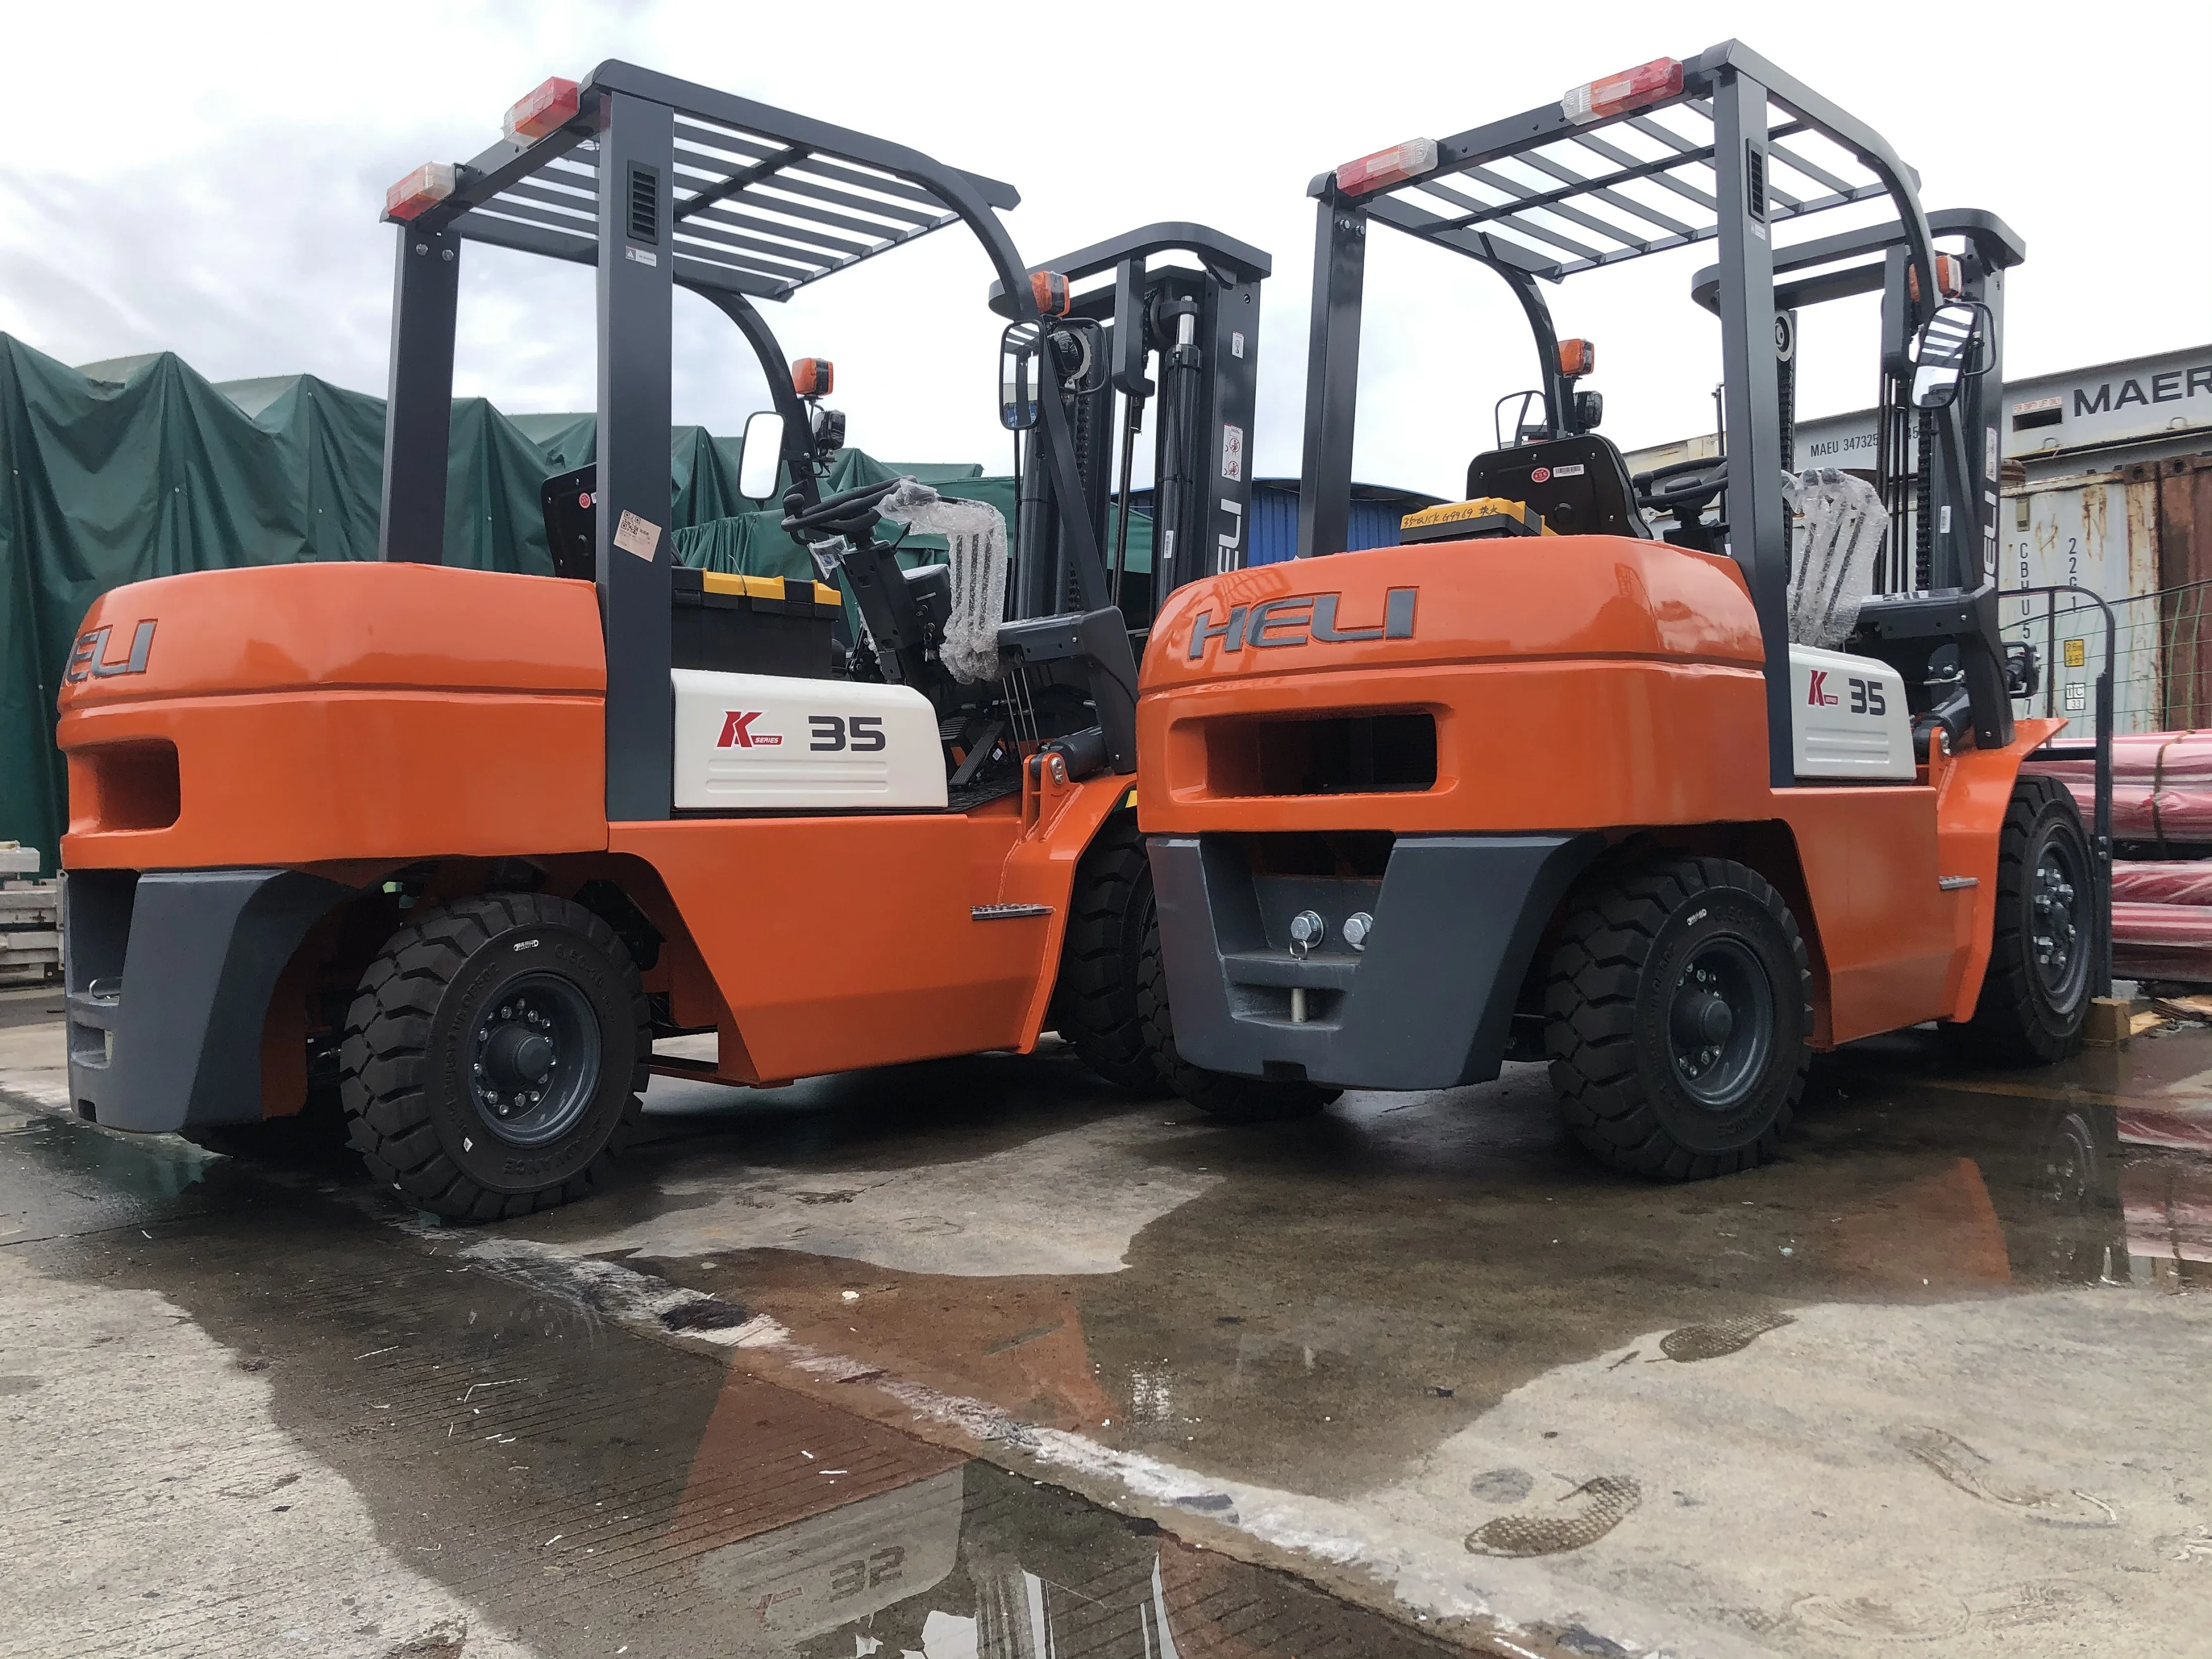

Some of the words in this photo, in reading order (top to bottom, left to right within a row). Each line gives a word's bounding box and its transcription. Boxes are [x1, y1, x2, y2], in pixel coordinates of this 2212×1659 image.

[2073, 364, 2212, 417] MAER
[1810, 441, 1839, 458] MAEU
[1189, 586, 1419, 660] HELI
[64, 619, 157, 684] ELI
[1808, 670, 1828, 706] K
[1849, 678, 1885, 715] 35
[717, 711, 763, 747] K
[808, 715, 885, 751] 35
